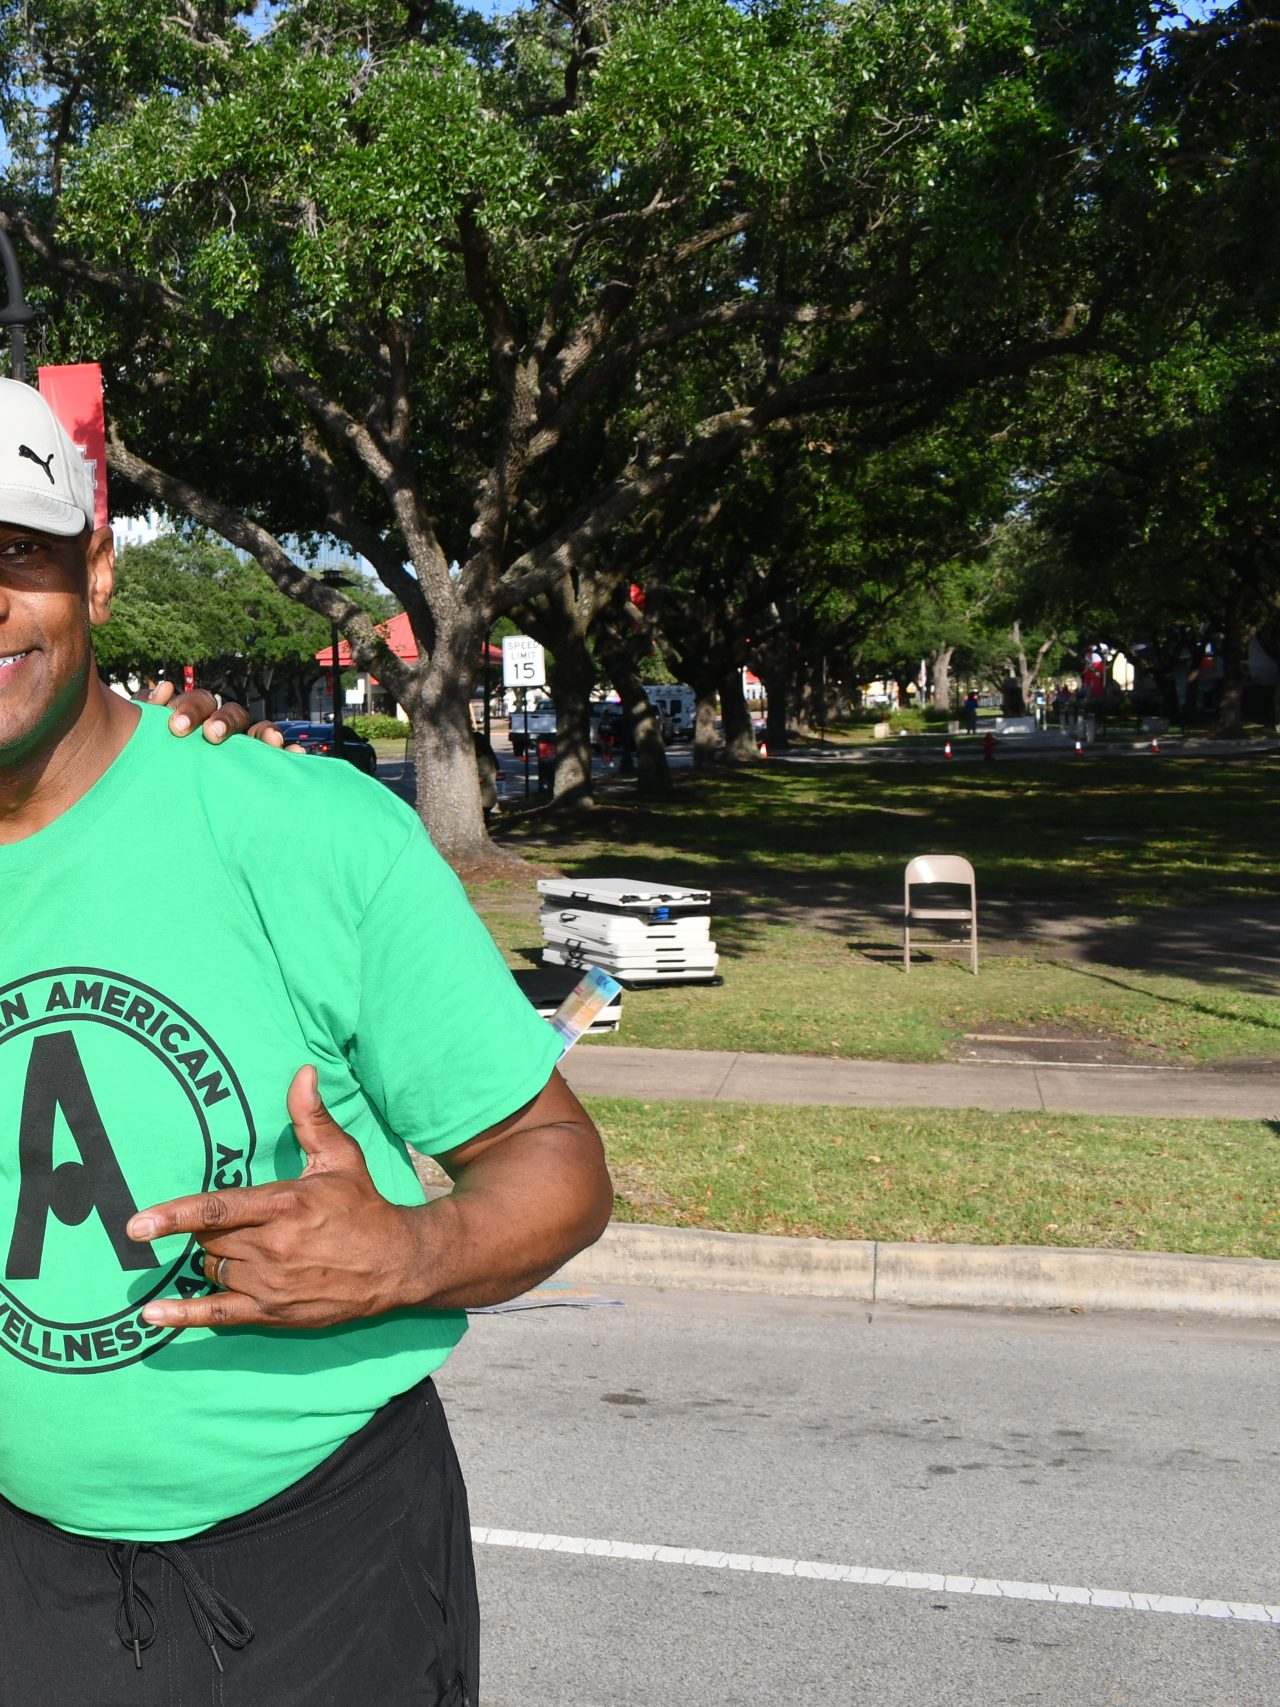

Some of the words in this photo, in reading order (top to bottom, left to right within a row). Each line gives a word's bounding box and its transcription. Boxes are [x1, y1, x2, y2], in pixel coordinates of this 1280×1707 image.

[507, 640, 539, 650] SPEED
[511, 650, 536, 661] LIMIT
[514, 662, 536, 680] 15
[45, 980, 231, 1108] AMERICAN
